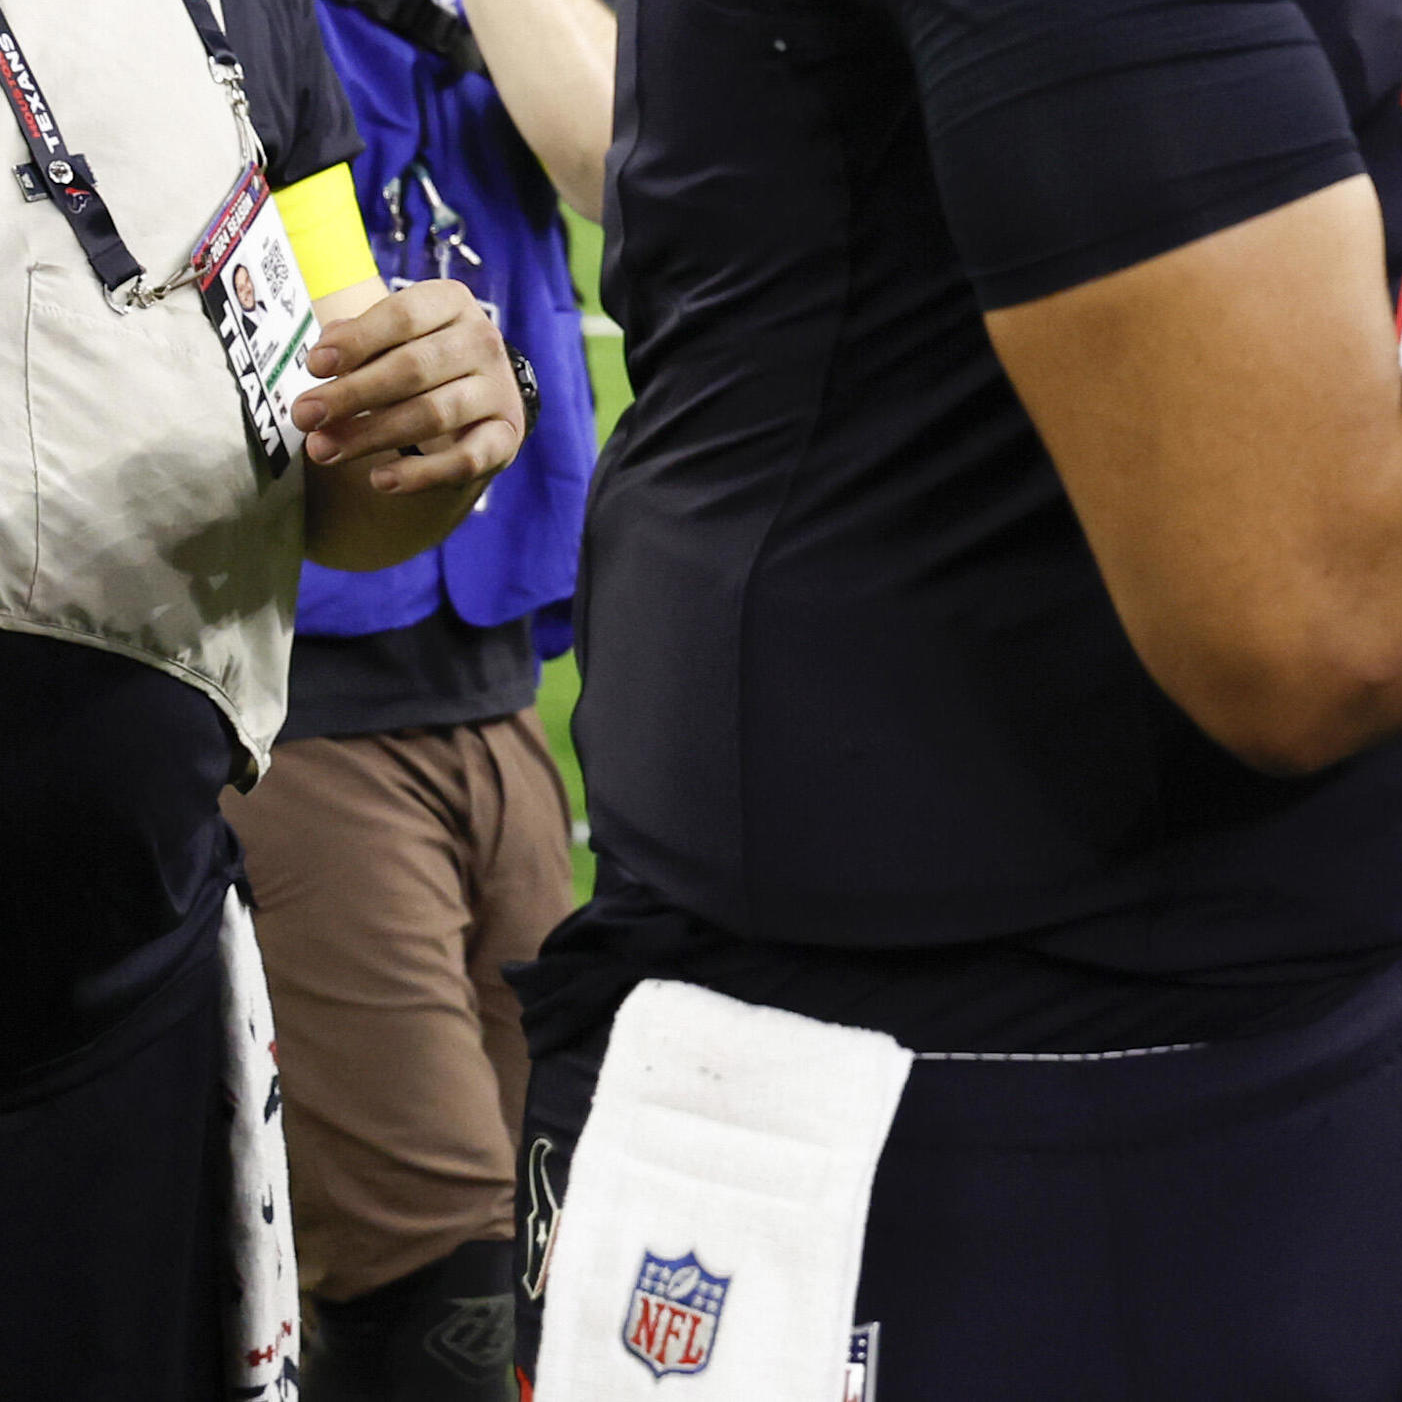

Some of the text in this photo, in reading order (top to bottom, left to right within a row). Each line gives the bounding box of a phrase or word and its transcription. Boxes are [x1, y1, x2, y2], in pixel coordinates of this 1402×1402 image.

[0, 32, 60, 154] TEXANS
[219, 300, 281, 457] TEAM
[630, 1297, 704, 1365] NFL
